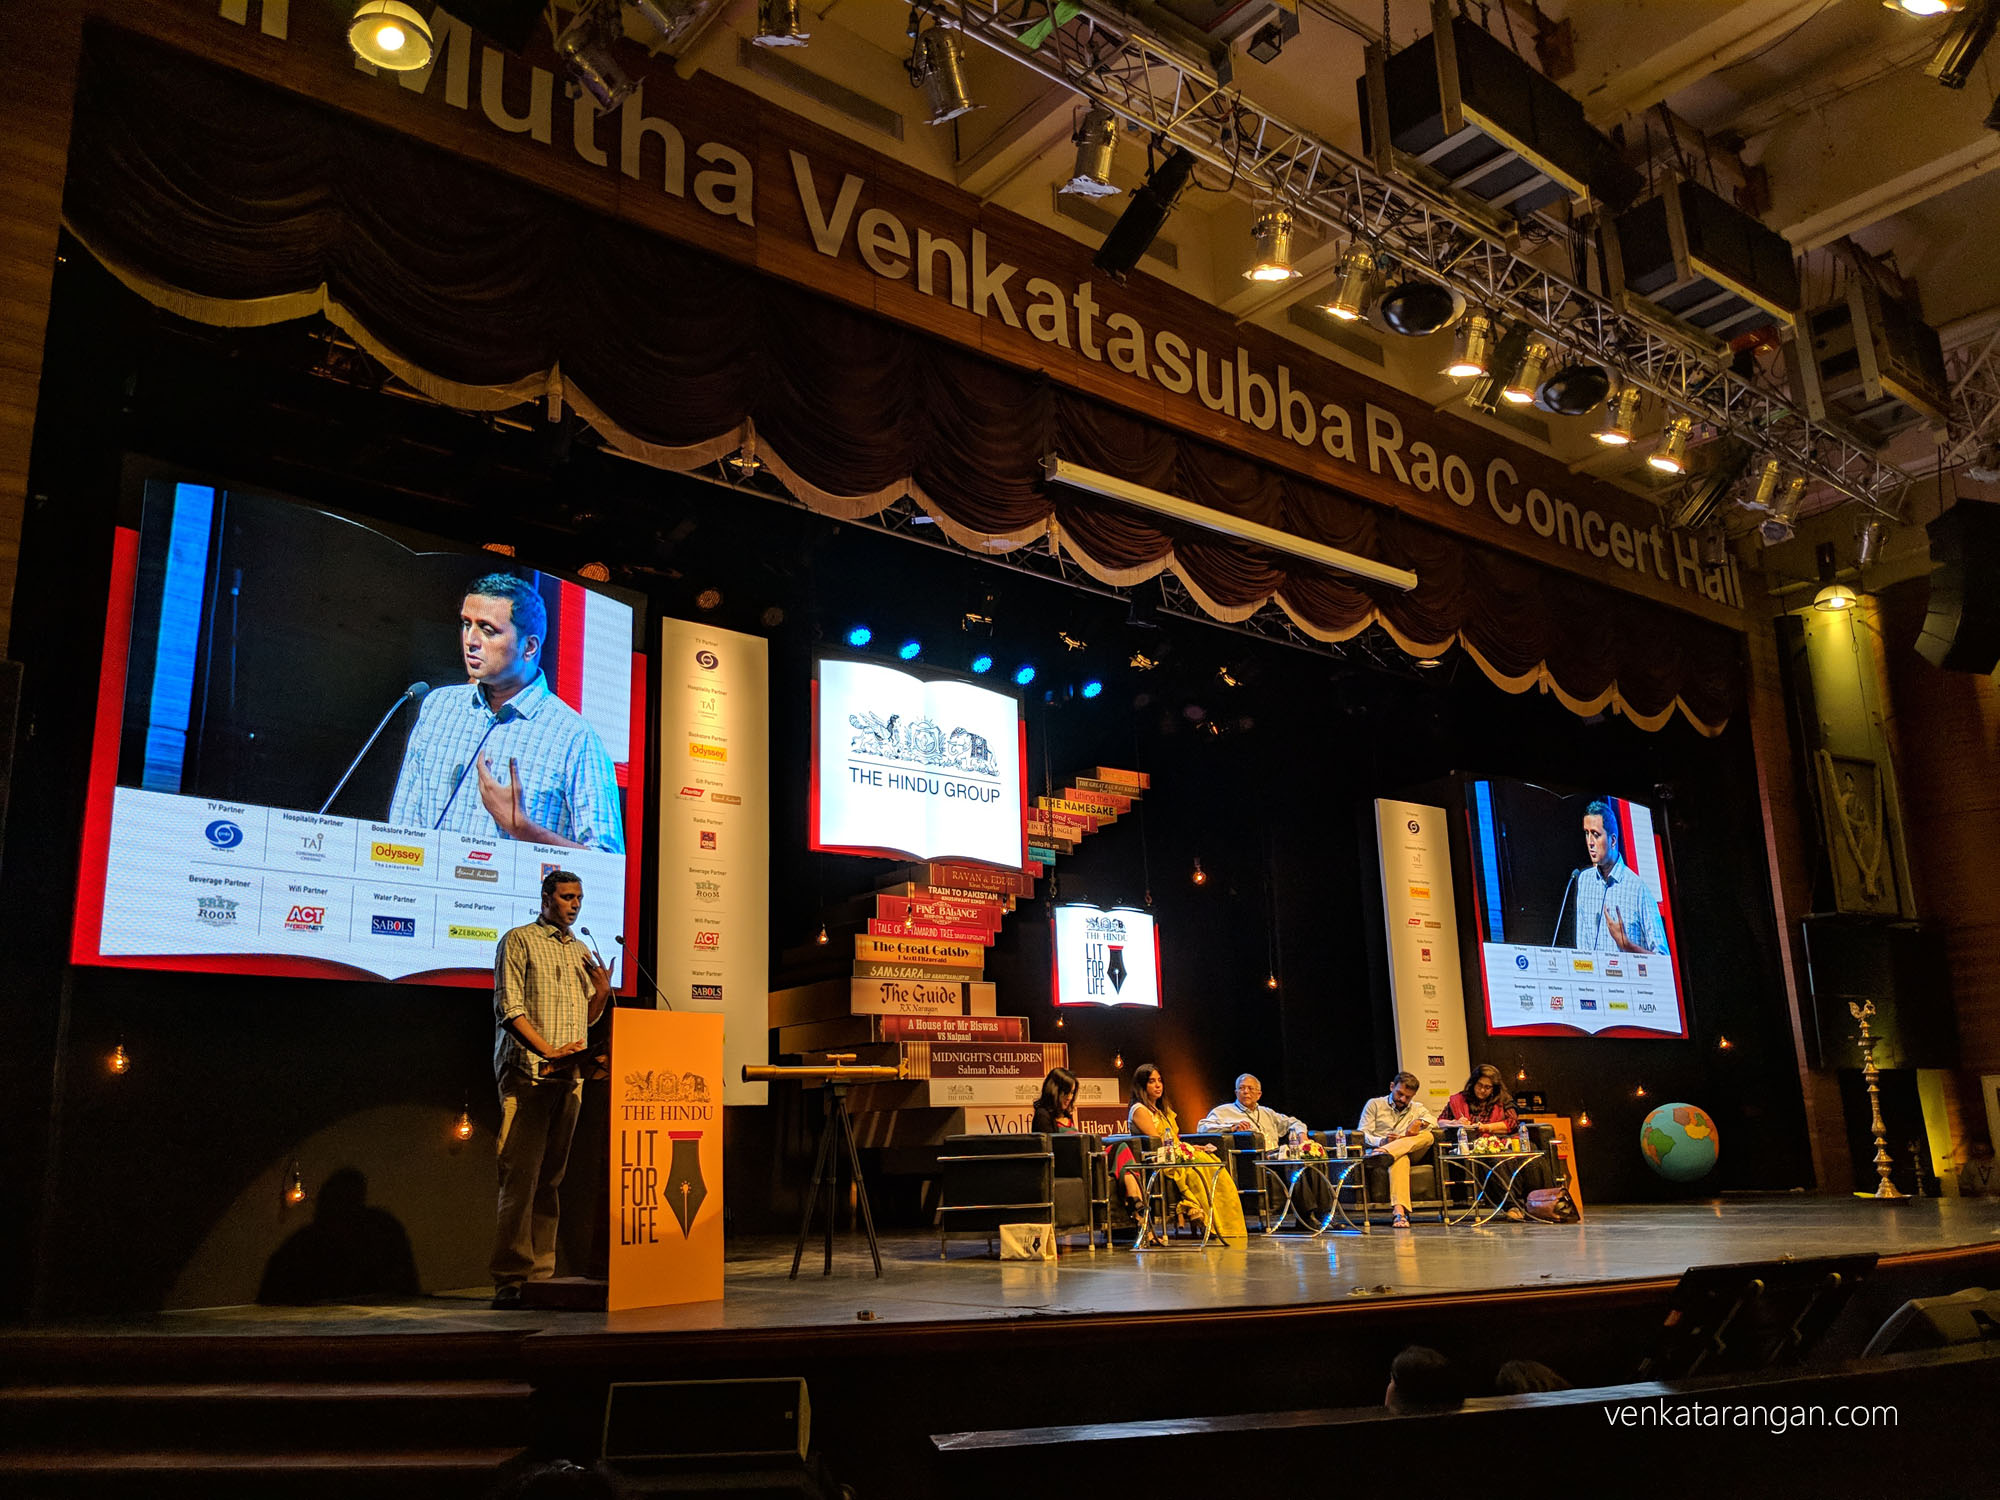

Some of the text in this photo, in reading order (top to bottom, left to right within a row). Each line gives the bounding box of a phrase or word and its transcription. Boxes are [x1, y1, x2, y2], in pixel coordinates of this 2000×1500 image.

[789, 149, 1357, 464] Venkatasubba
[1366, 402, 1475, 507] Rao
[1486, 457, 1670, 580] Concert
[1671, 530, 1744, 609] Hall
[692, 744, 725, 758] Odyssey
[849, 766, 1001, 803] THE HINDU GROUP
[207, 802, 245, 815] TV Partner
[1044, 798, 1061, 809] THE
[1064, 801, 1114, 817] NAMESAKE
[283, 813, 344, 828] Hospitality Partner
[371, 824, 426, 838] Bookstore Partner
[461, 836, 497, 847] Gift Partners
[375, 843, 420, 861] Odyssey
[533, 845, 569, 857] Radio Partner
[188, 874, 251, 888] Beverage Partner
[952, 870, 982, 883] RAVAN
[288, 885, 328, 896] Wifi Partner
[928, 885, 998, 901] TRAIN TO PAKISTAN
[373, 892, 417, 904] Water Partner
[454, 901, 496, 912] Sound Partner
[916, 903, 936, 915] FINE
[939, 905, 978, 920] BALANCE
[198, 908, 237, 920] ROOM
[286, 905, 325, 924] ACT
[372, 918, 414, 933] SABOLS
[878, 923, 892, 934] TALE
[893, 925, 902, 934] OF
[911, 925, 939, 938] TAMARIND
[940, 928, 954, 939] TREE
[457, 928, 498, 939] ZEBRONICS
[695, 932, 719, 945] ACT
[872, 941, 970, 958] The Great Gatsby
[1086, 943, 1103, 960] LIT
[870, 966, 924, 979] SAMSKARA
[1087, 960, 1104, 978] FOR
[692, 987, 722, 997] SABOLS
[880, 982, 957, 1005] The Guide
[1088, 978, 1106, 995] LIFE
[912, 1004, 939, 1015] Narayan
[1638, 1003, 1656, 1012] AURA
[908, 1019, 999, 1033] A House for Mr Biswas
[937, 1032, 971, 1043] VS Naipaul
[932, 1051, 1043, 1063] MIDNIGHT'S CHILDREN
[957, 1065, 1020, 1076] Salman Rushdie
[621, 1105, 714, 1121] THE HINDU
[1081, 1120, 1114, 1136] Hilary
[621, 1130, 659, 1168] LIT
[621, 1167, 659, 1207] FOR
[621, 1206, 659, 1246] LIFE
